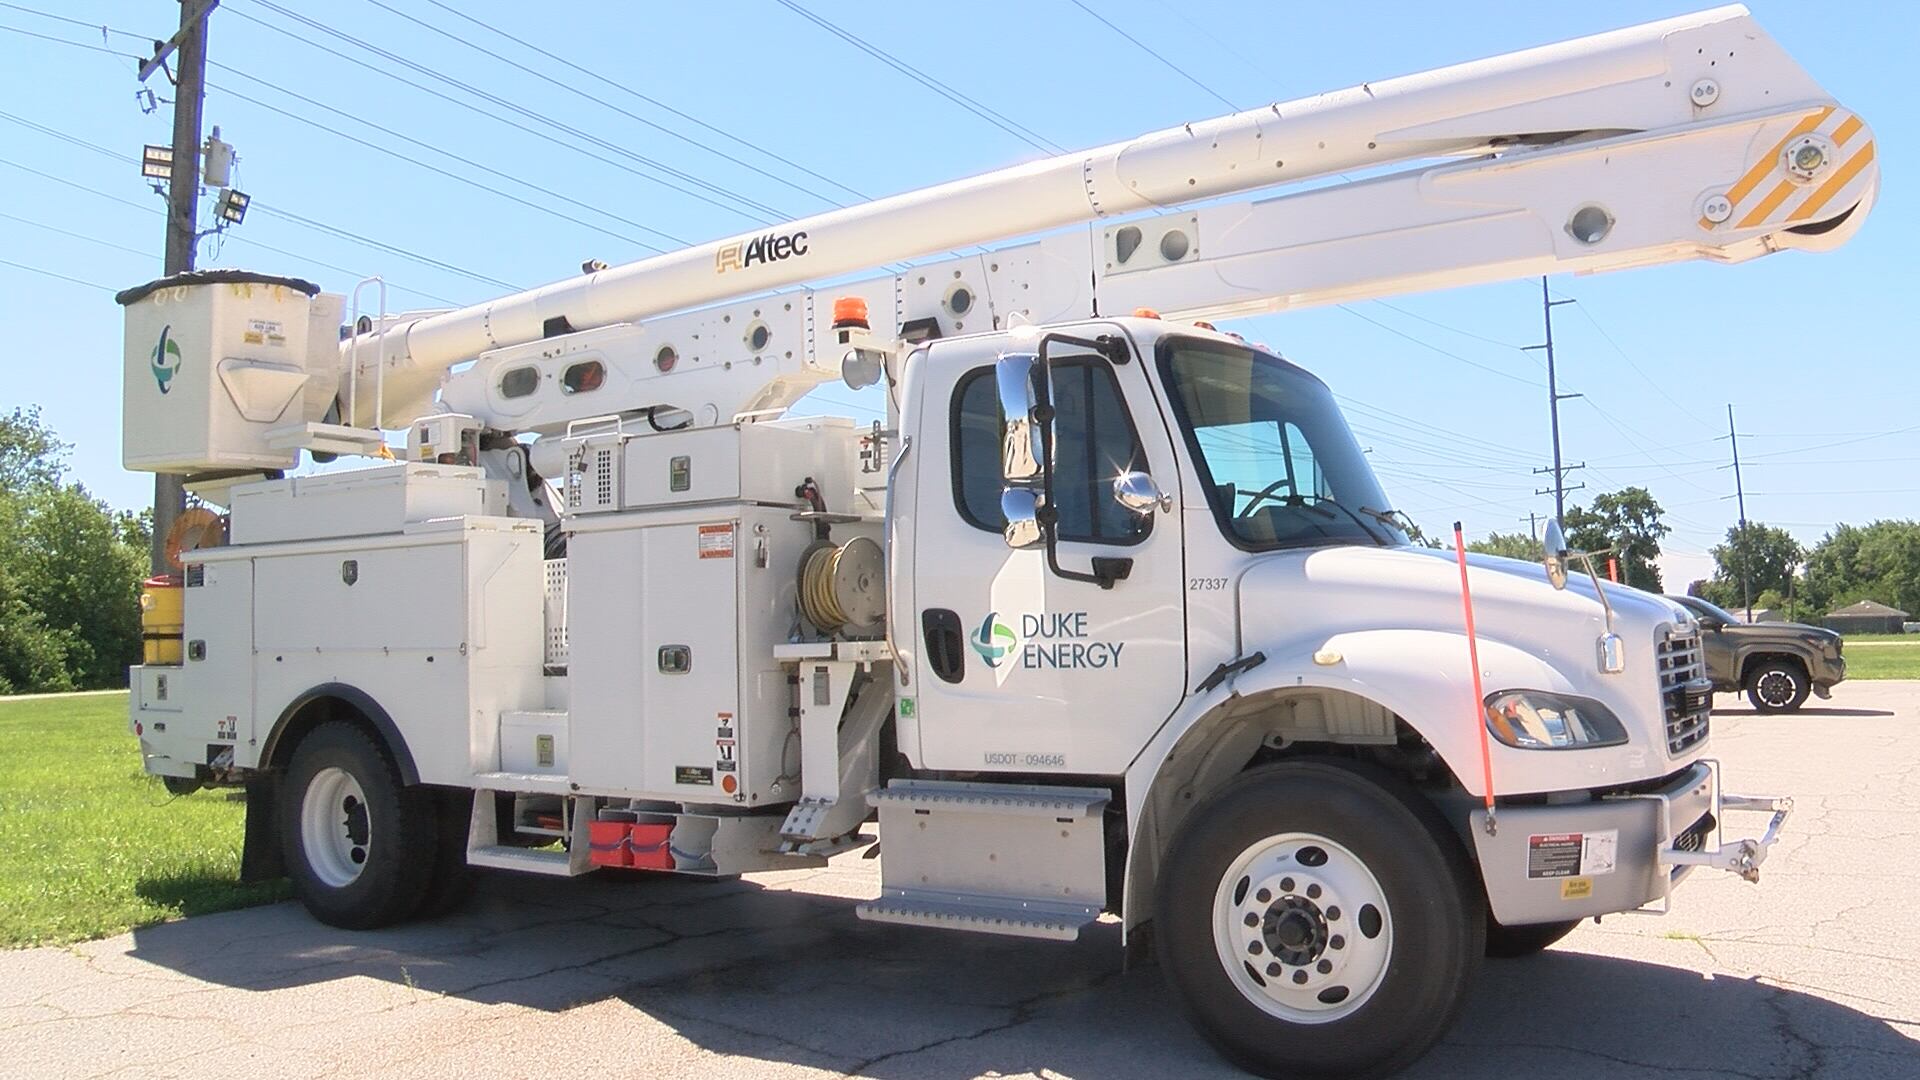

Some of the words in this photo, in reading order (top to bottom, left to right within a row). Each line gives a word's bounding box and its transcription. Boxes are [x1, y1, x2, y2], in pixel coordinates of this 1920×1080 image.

[744, 232, 808, 267] Altec
[1190, 578, 1228, 590] 27337
[1023, 612, 1088, 638] DUKE
[1024, 642, 1124, 669] ENERGY
[984, 753, 1017, 764] USDOT
[1025, 754, 1065, 766] 094646
